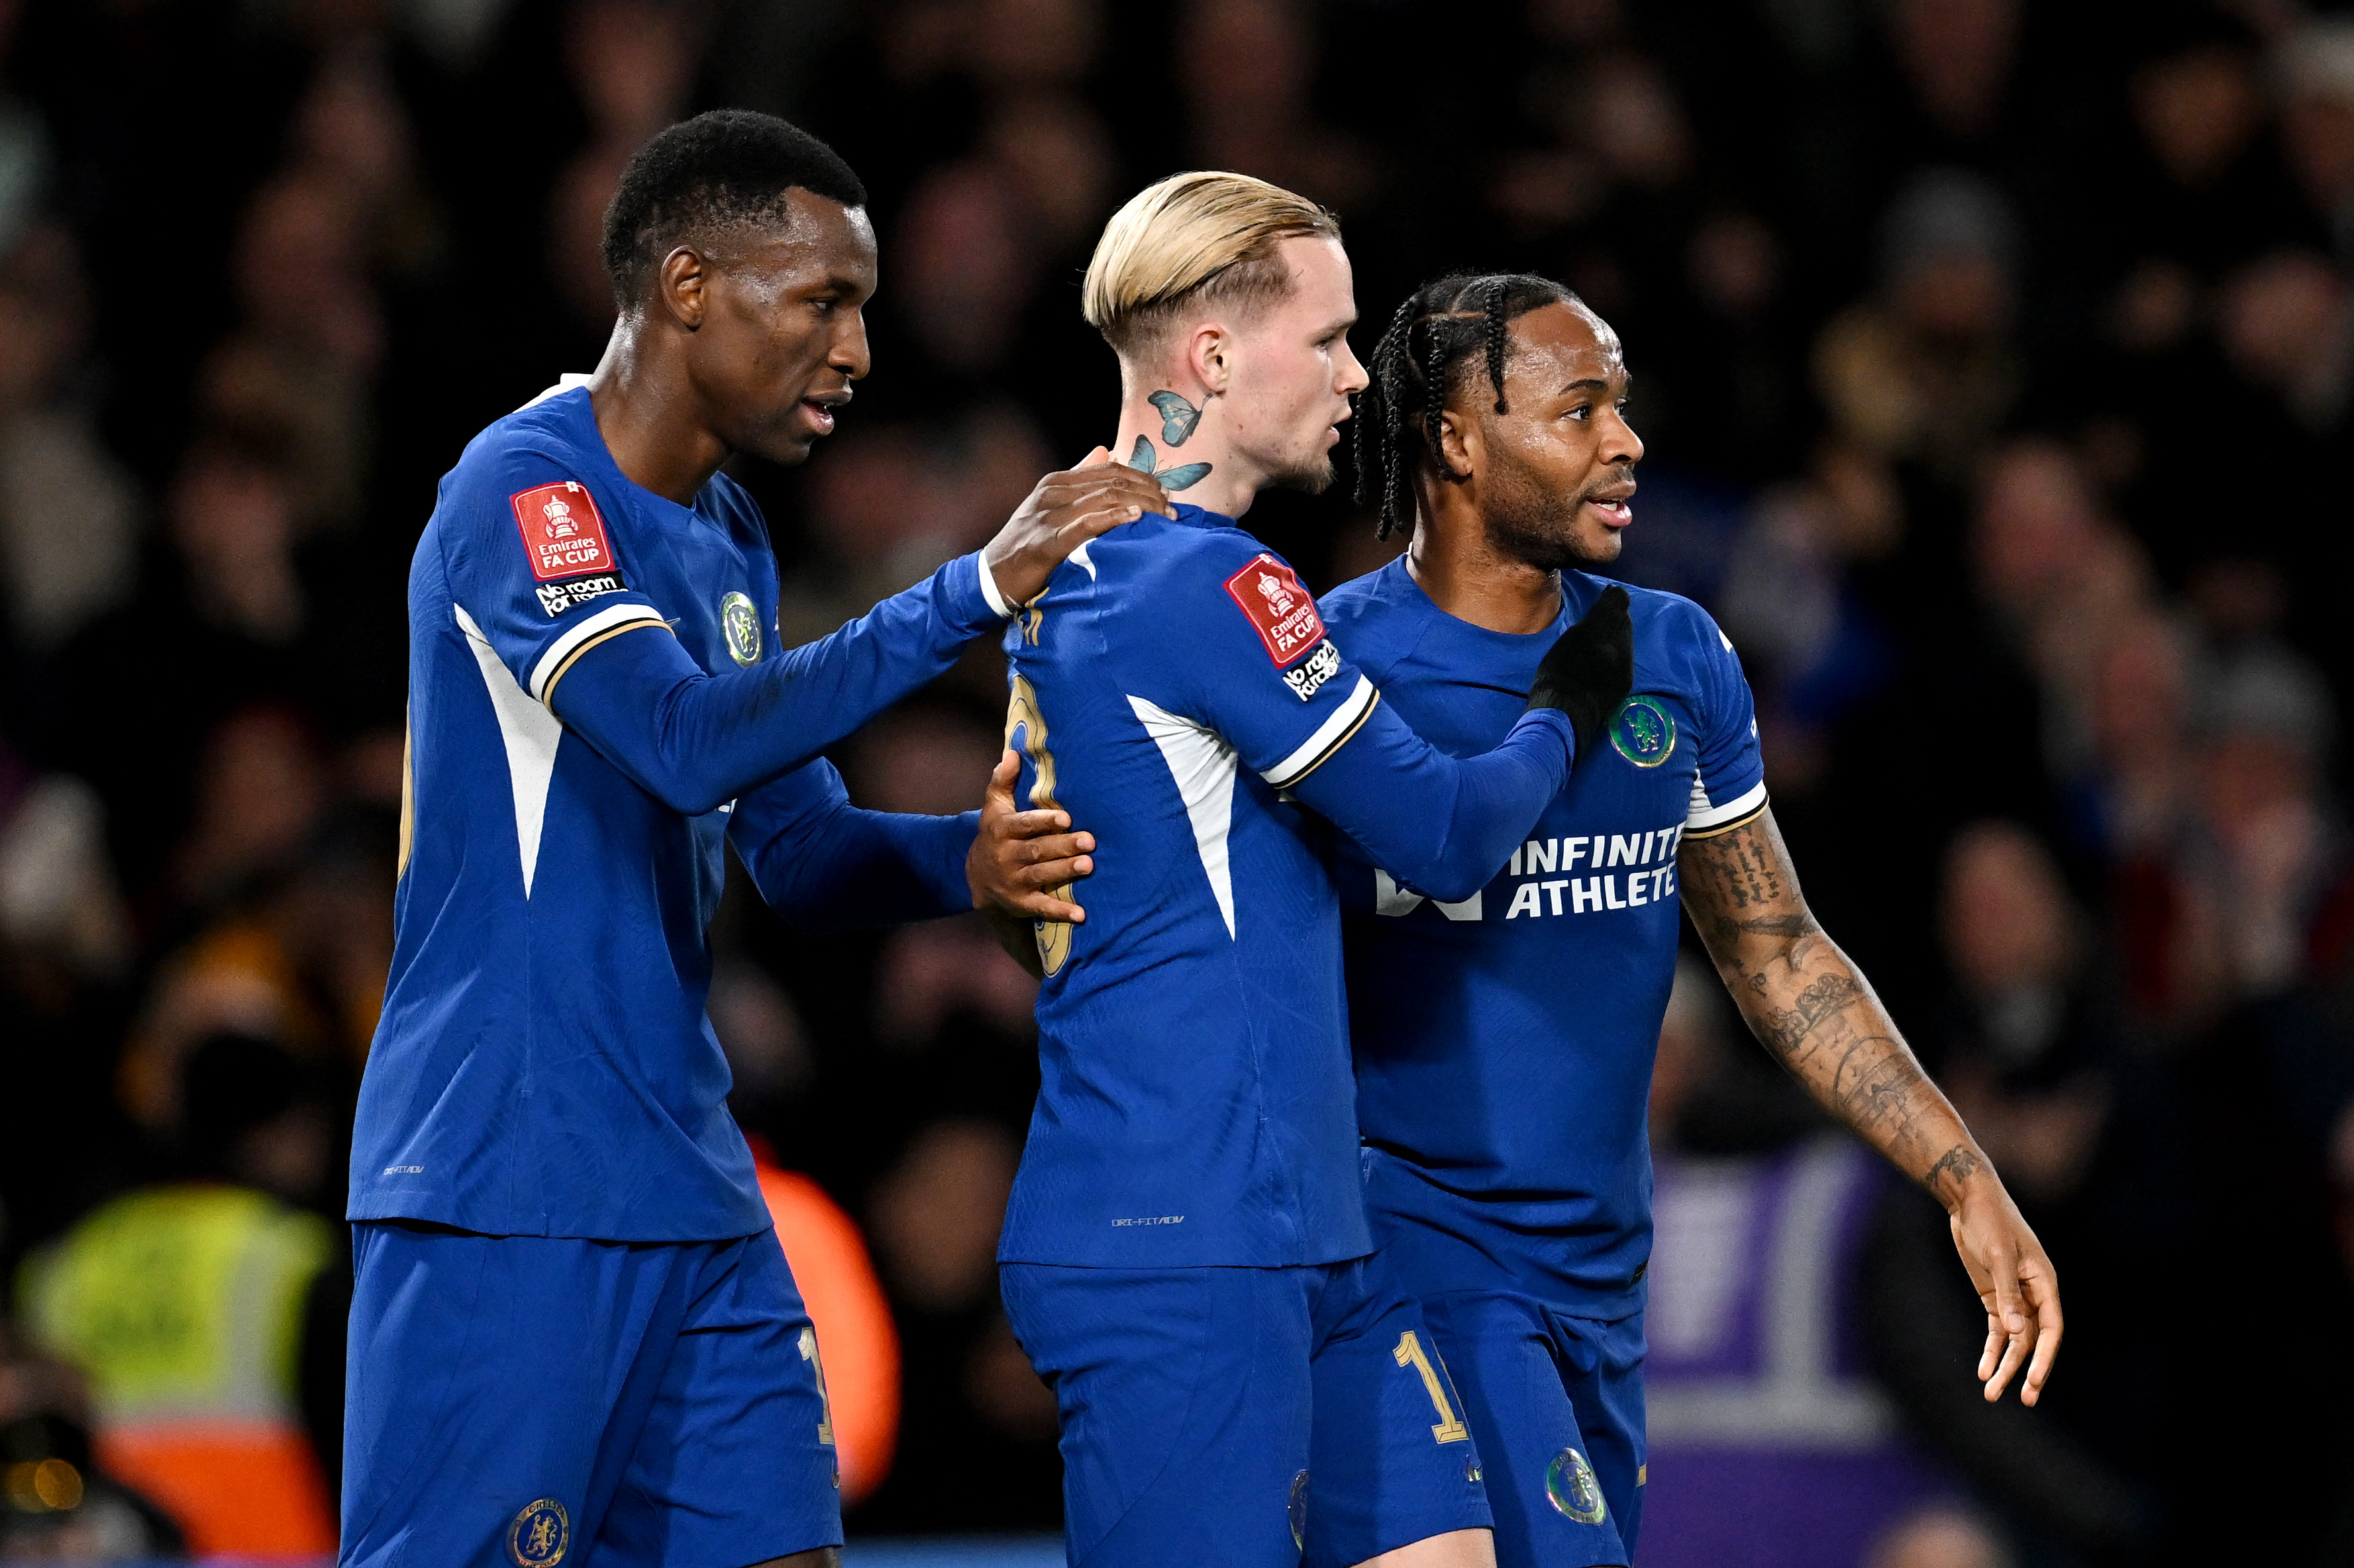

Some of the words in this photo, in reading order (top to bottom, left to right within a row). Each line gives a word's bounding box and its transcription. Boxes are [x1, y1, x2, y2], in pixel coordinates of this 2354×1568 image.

[538, 538, 596, 556] Emirates
[542, 555, 564, 569] FA
[566, 548, 599, 564] CUP
[536, 584, 566, 605] No
[566, 577, 617, 594] room
[544, 595, 570, 618] for
[1270, 603, 1310, 639] Emirates
[1277, 633, 1298, 652] FA
[1294, 614, 1315, 638] CUP
[1282, 669, 1305, 691] No
[1510, 820, 1686, 876] INFINITE
[1506, 860, 1676, 919] ATHLETE
[1393, 1330, 1469, 1445] 1
